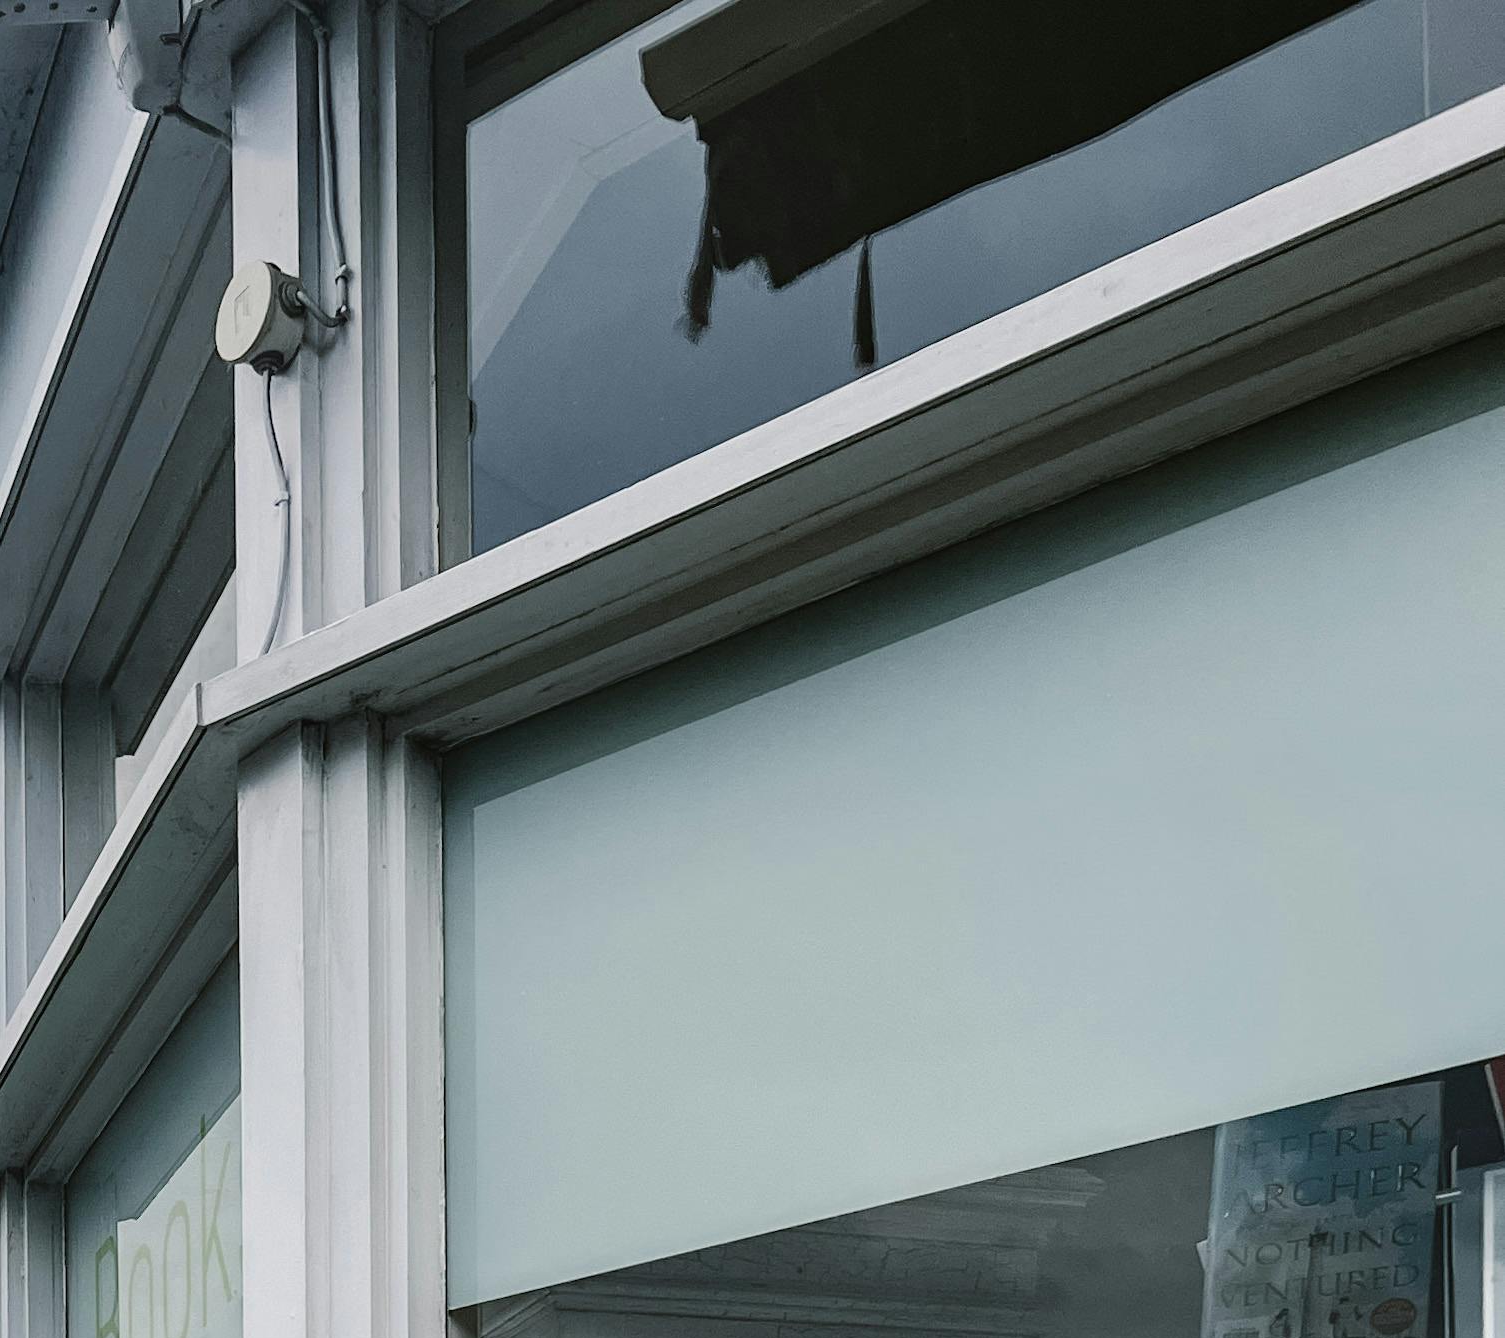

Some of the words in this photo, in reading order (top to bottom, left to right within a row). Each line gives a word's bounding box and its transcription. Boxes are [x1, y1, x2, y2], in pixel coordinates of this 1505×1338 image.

[1237, 1161, 1427, 1214] ARCHER
[1227, 1222, 1419, 1268] NOTHING
[1220, 1263, 1421, 1308] VENTURED
